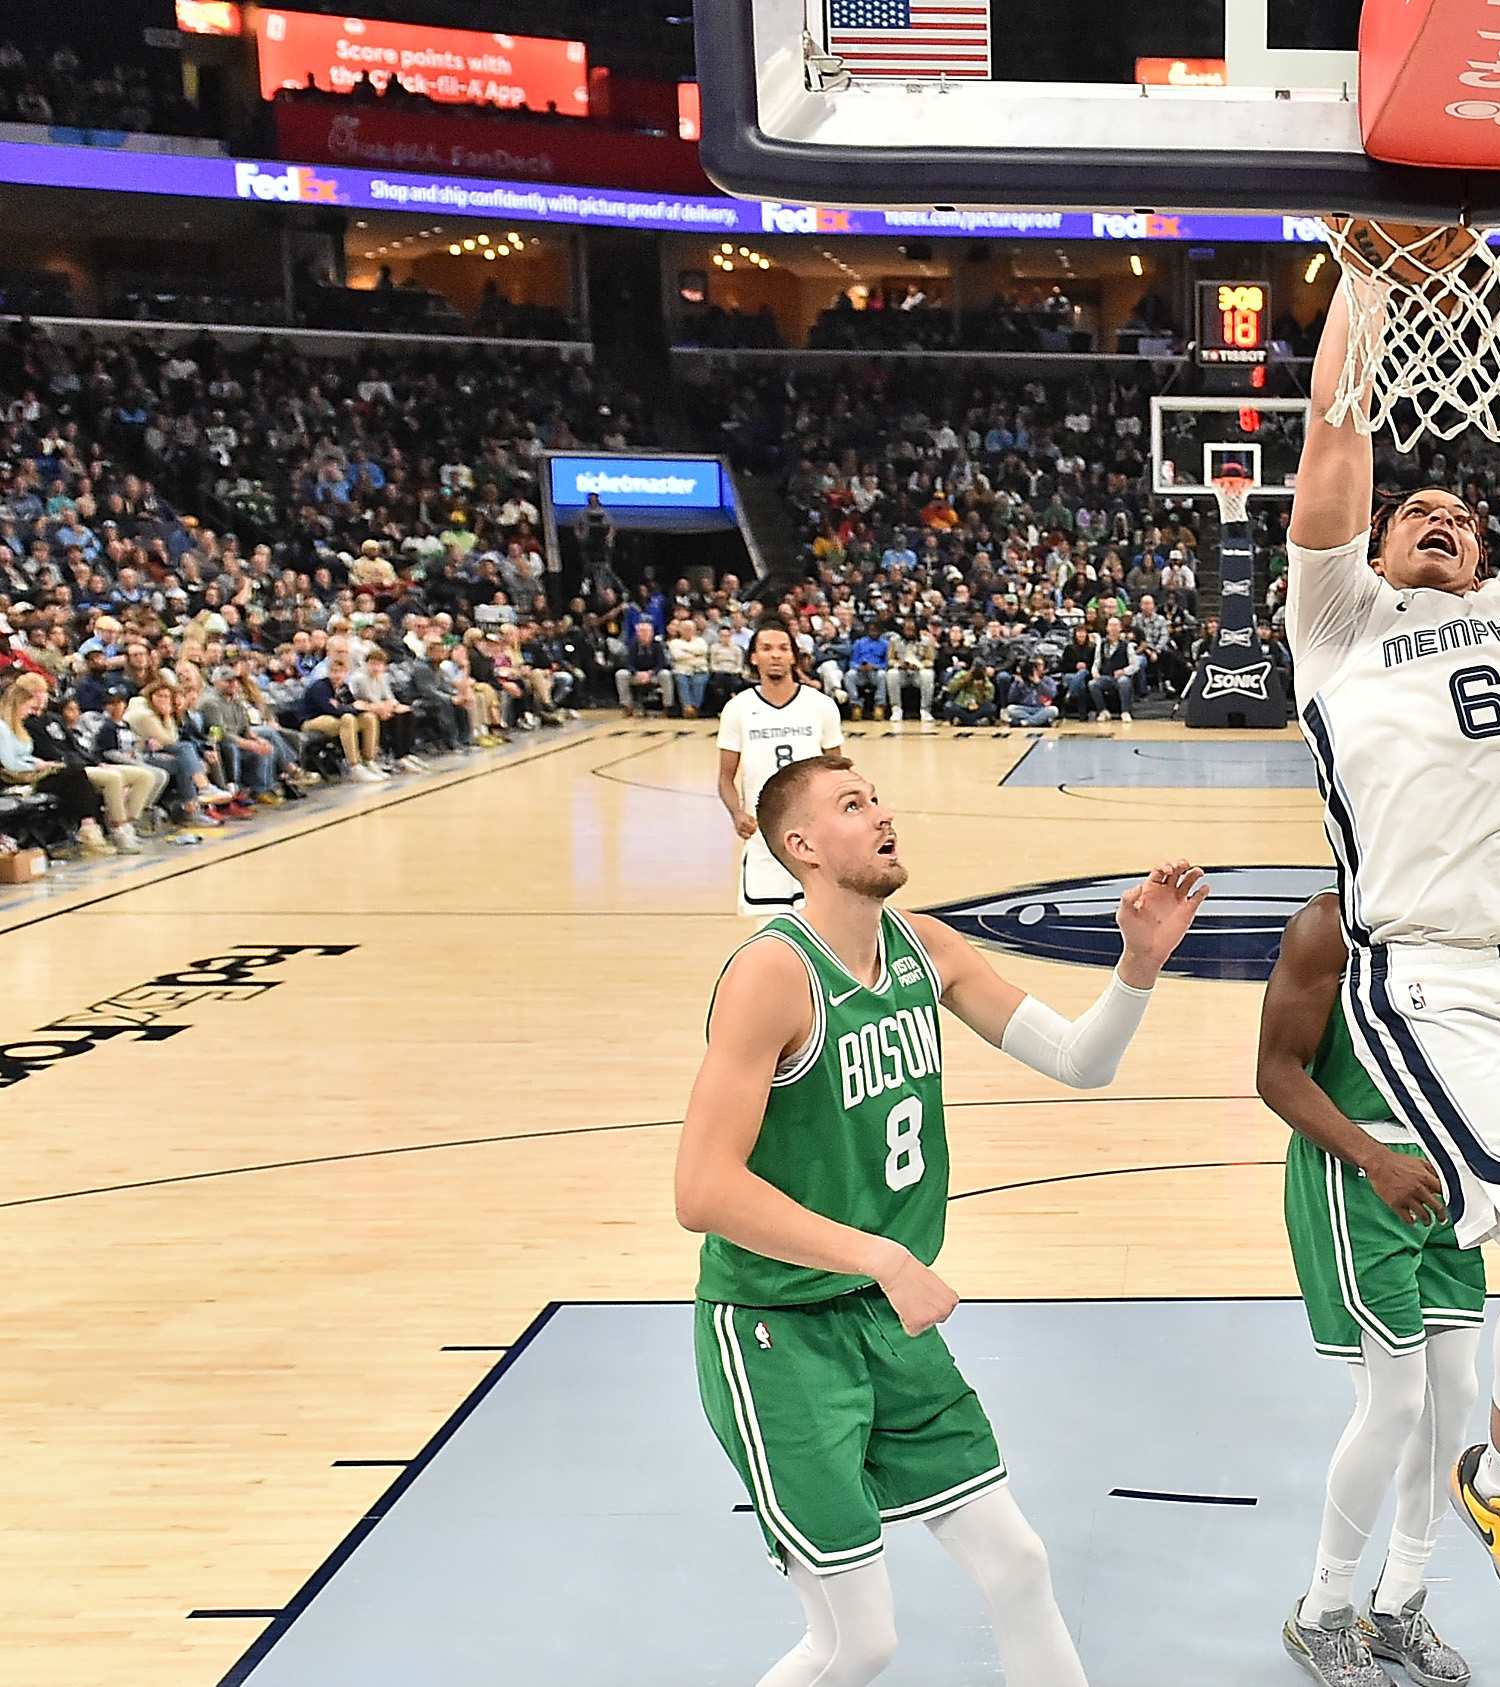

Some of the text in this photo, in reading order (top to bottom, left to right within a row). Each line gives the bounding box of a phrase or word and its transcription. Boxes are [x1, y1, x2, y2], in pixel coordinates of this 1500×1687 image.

[336, 39, 513, 76] Score points with
[235, 162, 338, 202] FedEx
[370, 180, 410, 203] Shop
[410, 184, 436, 203] and
[437, 185, 468, 208] ship
[1223, 310, 1258, 347] 18
[1211, 673, 1261, 690] SONIC
[749, 725, 813, 741] MEMPHIS
[774, 744, 794, 769] 8
[885, 1095, 926, 1192] 8
